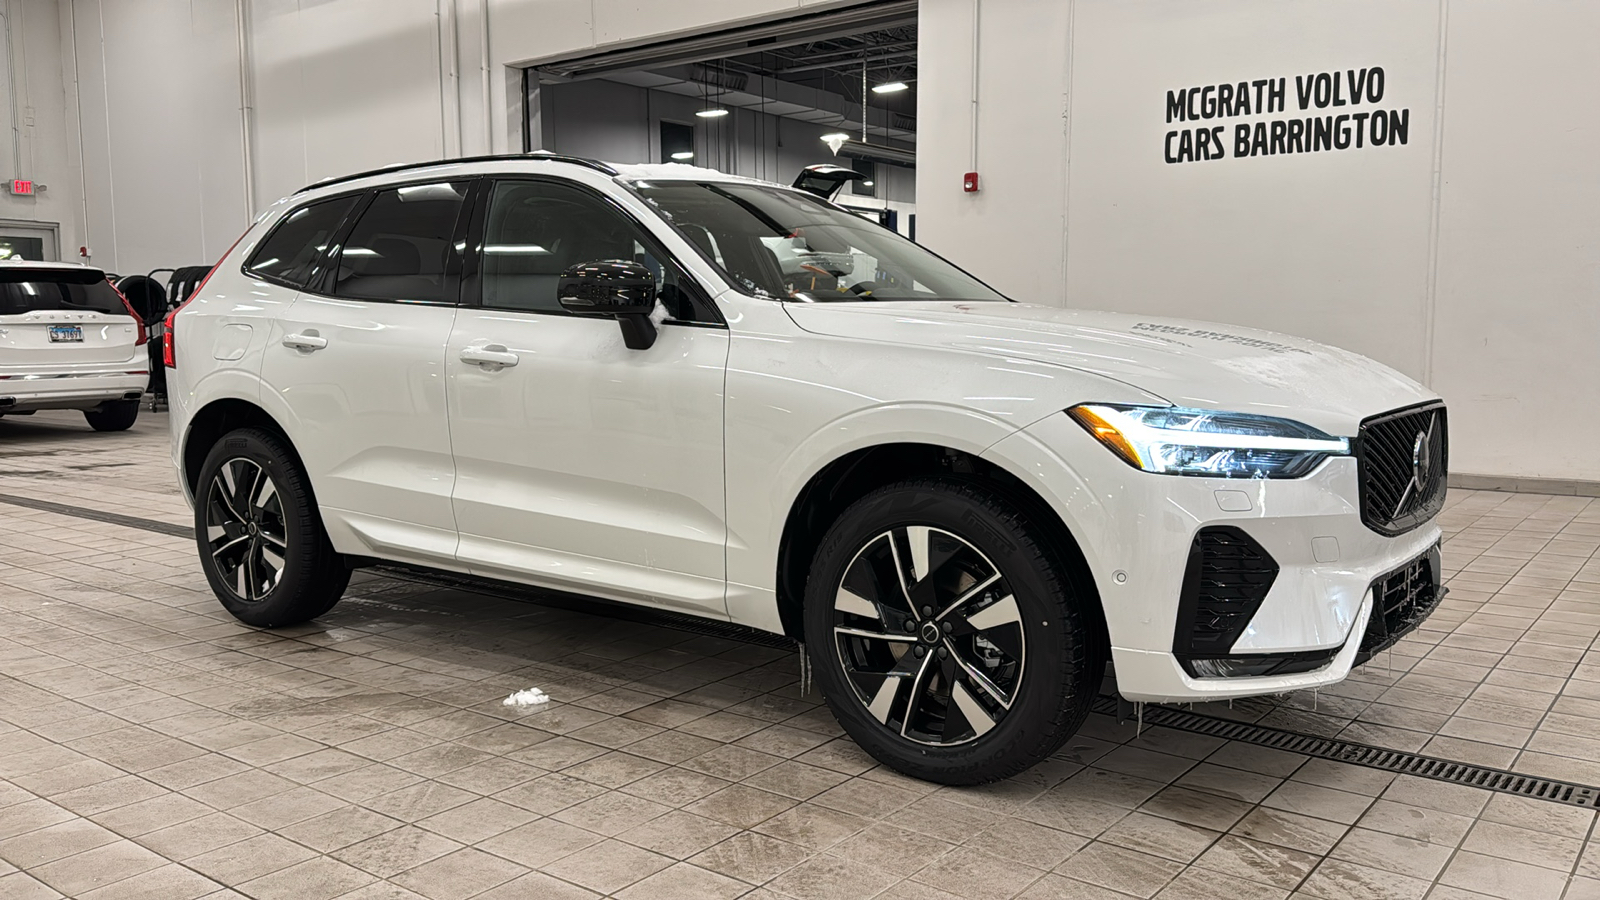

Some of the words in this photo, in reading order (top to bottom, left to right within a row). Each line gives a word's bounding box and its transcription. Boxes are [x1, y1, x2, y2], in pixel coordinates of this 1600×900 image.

[1166, 77, 1286, 124] MCGRATH
[1296, 66, 1385, 110] VOLVO
[1164, 125, 1225, 164] CARS
[1233, 108, 1410, 158] BARRINGTON
[14, 180, 32, 194] EXIT
